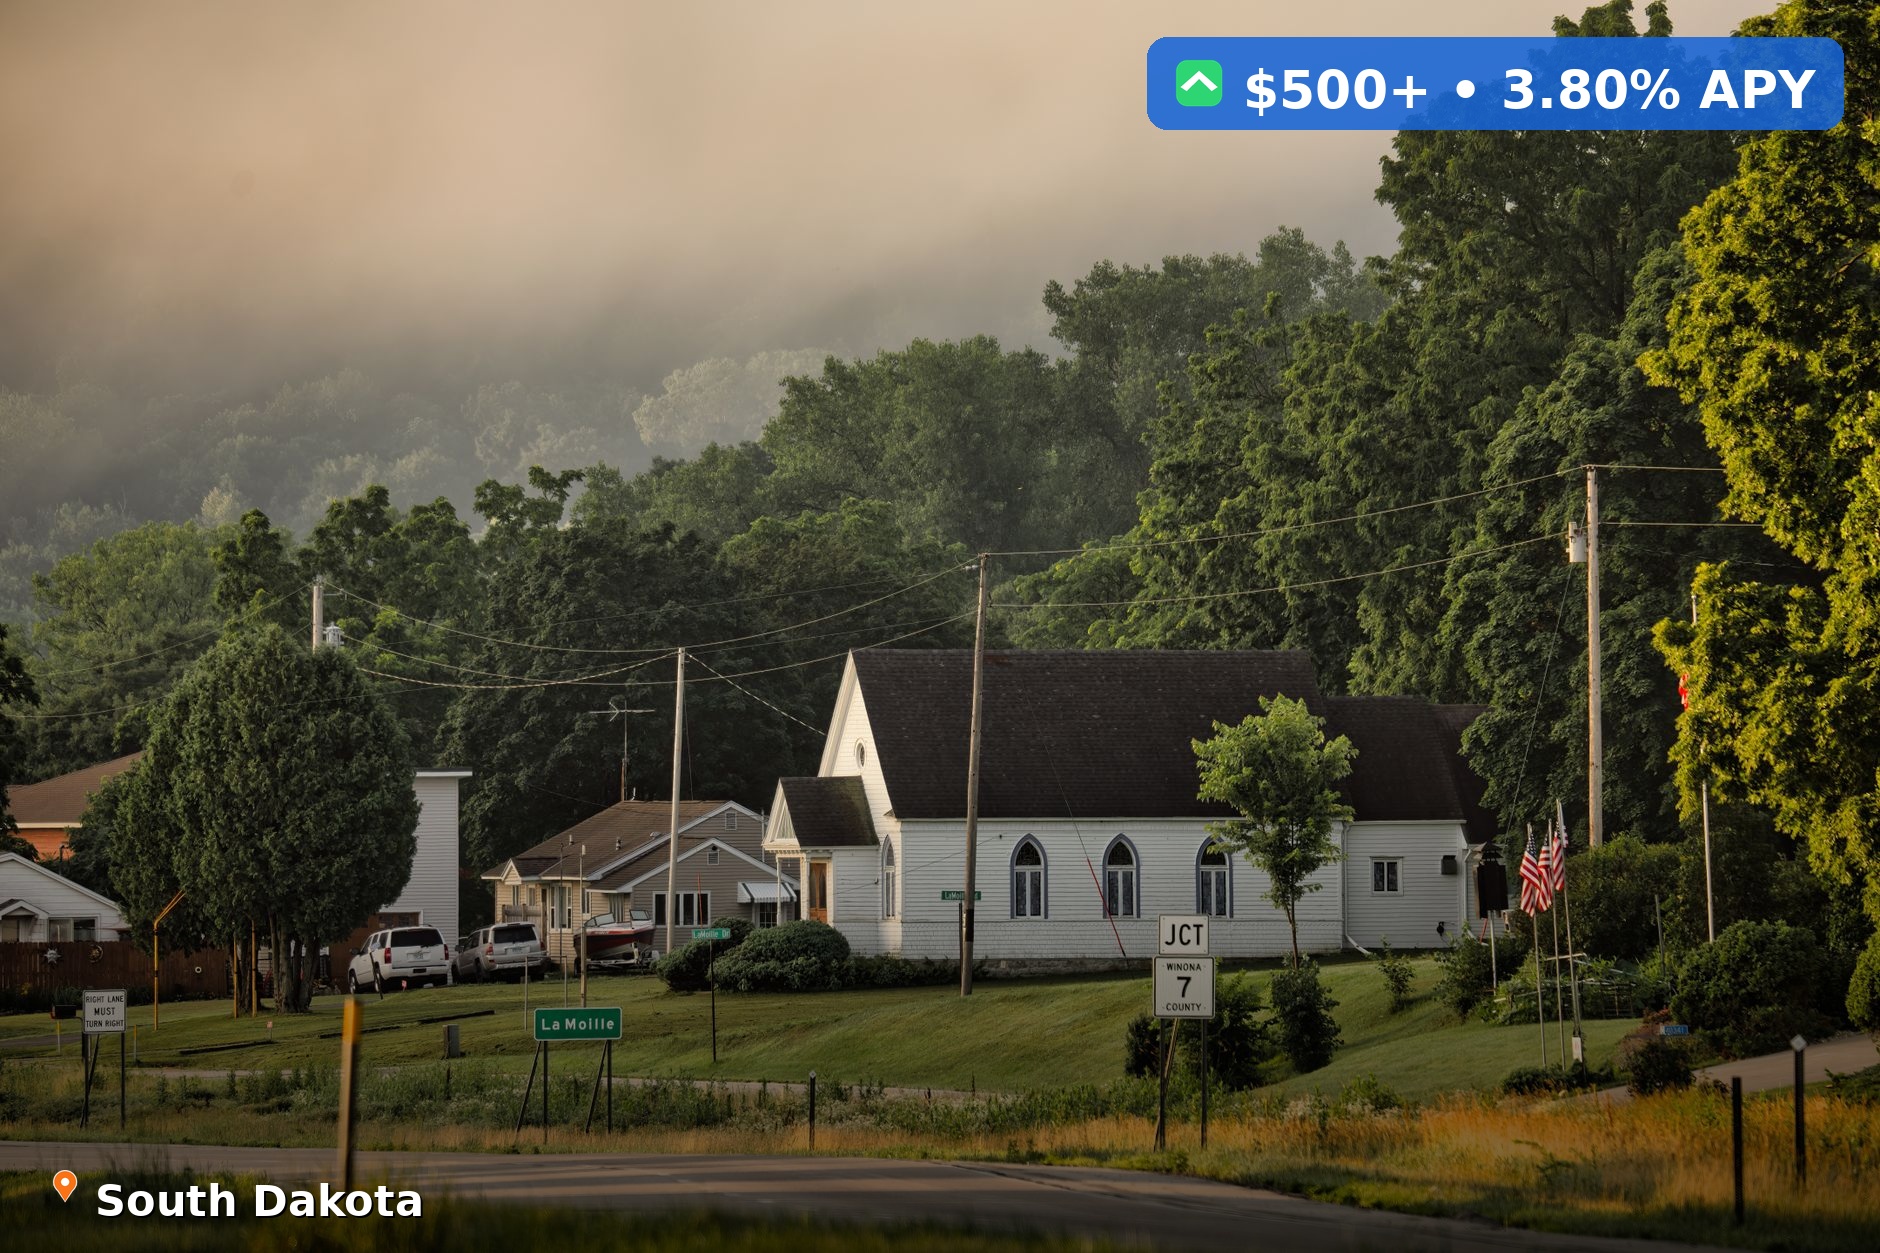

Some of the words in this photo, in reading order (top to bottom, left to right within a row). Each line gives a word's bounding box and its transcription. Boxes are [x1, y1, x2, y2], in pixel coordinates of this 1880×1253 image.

[1164, 923, 1204, 946] JCT
[1166, 962, 1202, 972] WINONA
[1176, 976, 1192, 998] 7
[85, 995, 105, 1003] RIGHT
[107, 995, 124, 1003] LANE
[94, 1007, 115, 1016] MUST
[1165, 1002, 1202, 1012] COUNTY
[86, 1020, 103, 1028] TURN
[105, 1020, 124, 1028] RIGHT
[541, 1018, 560, 1031] La
[565, 1018, 615, 1031] Moille
